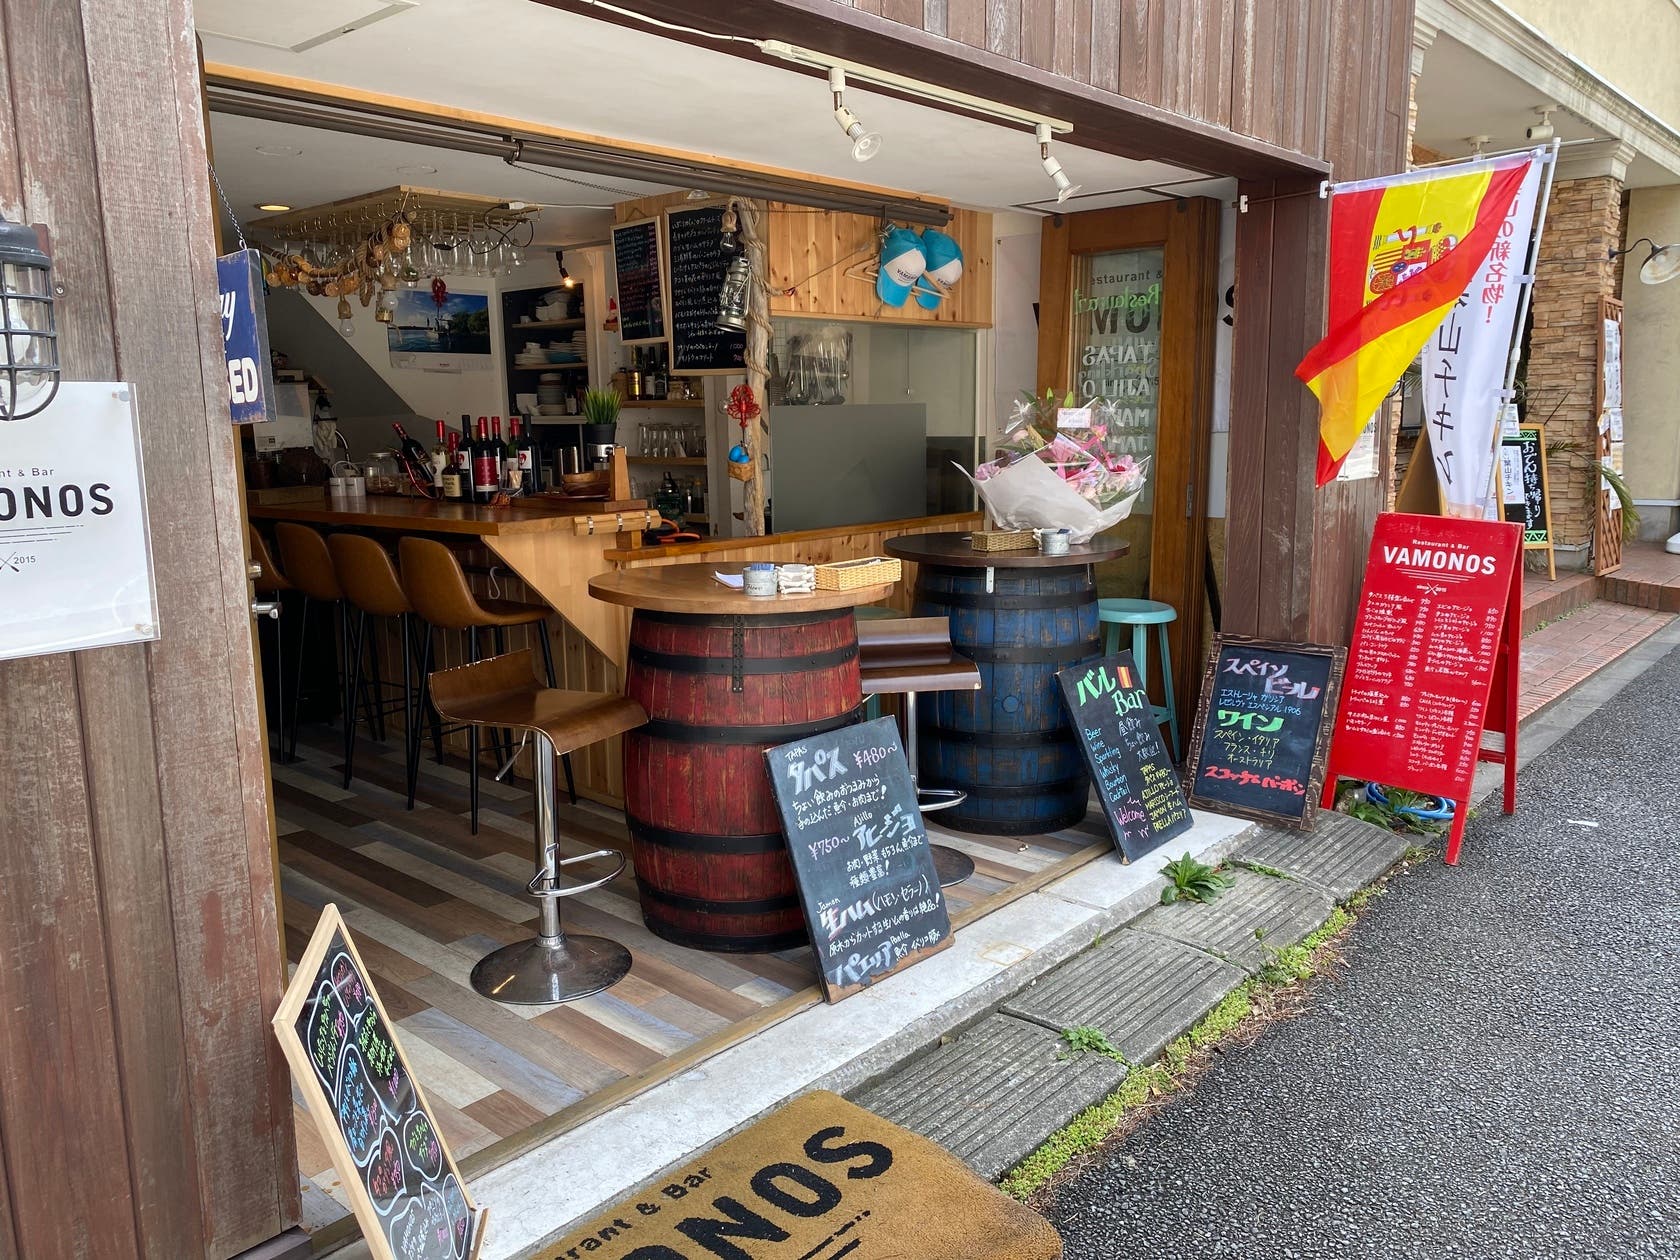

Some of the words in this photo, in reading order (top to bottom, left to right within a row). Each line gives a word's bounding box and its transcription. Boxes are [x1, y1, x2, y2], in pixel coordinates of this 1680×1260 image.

[227, 357, 259, 404] ED
[18, 469, 25, 477] &
[32, 467, 55, 477] Bar
[1412, 539, 1449, 548] Restaurant
[1458, 543, 1470, 551] Bar
[14, 555, 37, 565] 2015
[1383, 546, 1497, 575] VAMONOS
[1222, 658, 1289, 679] スペイン
[1076, 666, 1116, 707] バル
[1220, 688, 1257, 700] エストレーリャ
[1261, 693, 1285, 704] ガリシア
[1264, 677, 1321, 700] ビール
[1111, 689, 1146, 717] Bar
[1284, 706, 1302, 716] 1906
[1217, 709, 1285, 732] ワイン
[1085, 727, 1102, 741] Beer
[1213, 729, 1280, 749] スペイン・イタリア
[784, 745, 808, 762] TAPAS
[1090, 740, 1106, 752] Wine
[1094, 747, 1122, 764] Sparkling
[787, 746, 849, 795] タパス
[1227, 753, 1273, 770] オーストラリア
[1104, 774, 1128, 791] Bourbon
[1113, 805, 1147, 827] Welcome
[852, 803, 917, 851] アヒージョ
[820, 899, 875, 942] 生ハム
[826, 940, 893, 986] パエリア
[635, 1200, 662, 1216] &
[660, 1167, 714, 1200] Bar
